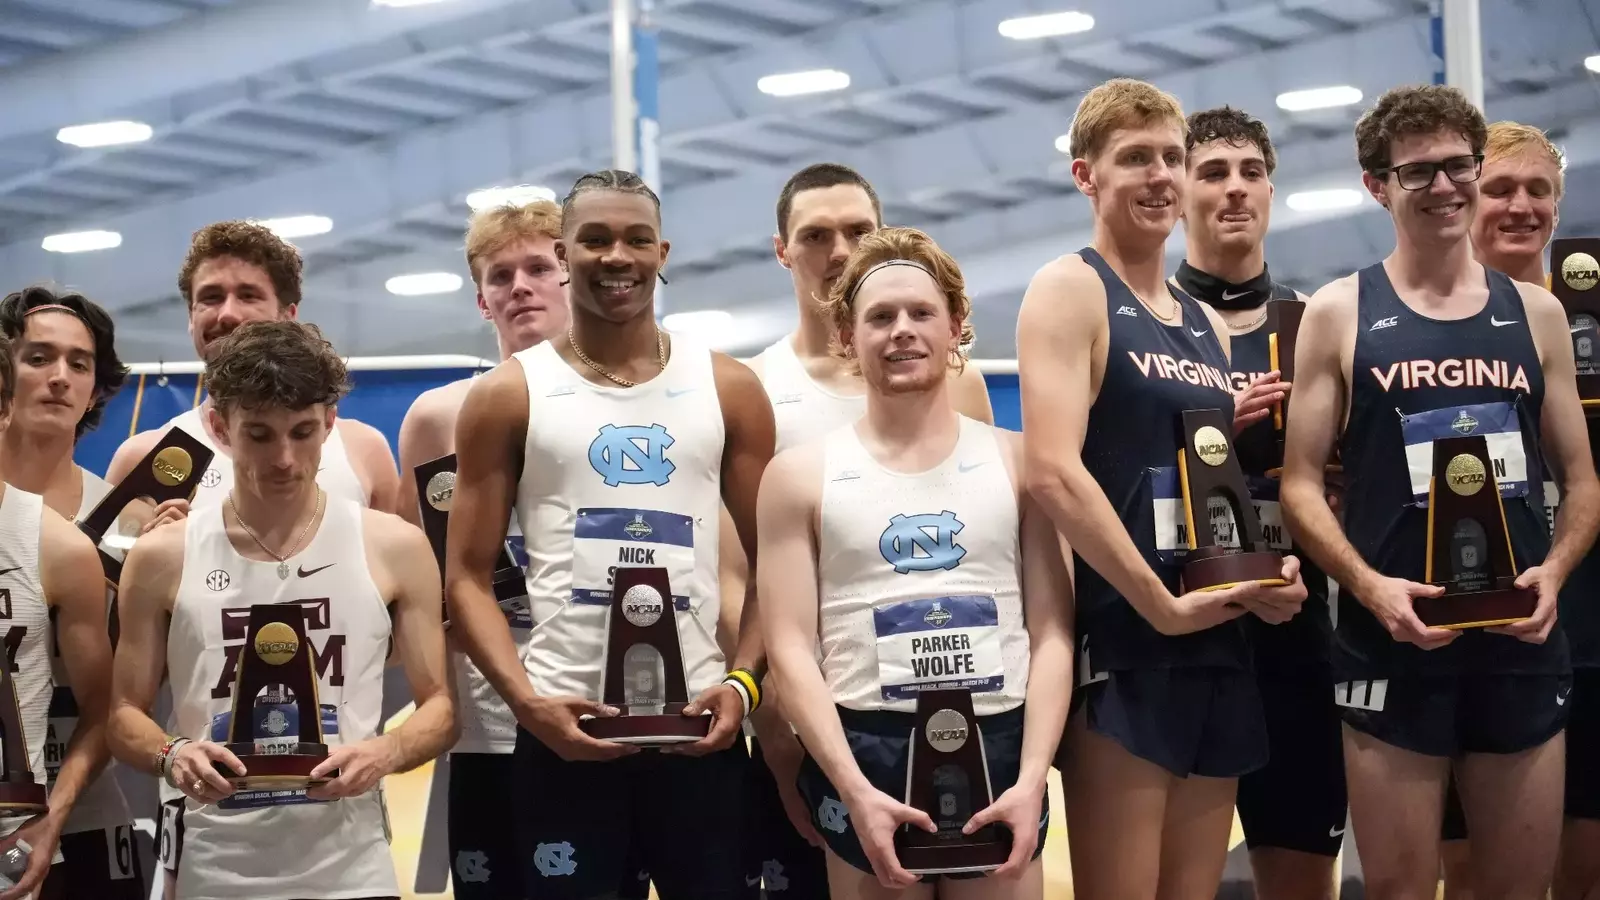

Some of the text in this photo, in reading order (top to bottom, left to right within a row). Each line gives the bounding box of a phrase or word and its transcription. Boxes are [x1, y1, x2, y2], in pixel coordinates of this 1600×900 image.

[1566, 271, 1600, 282] NCAA
[1117, 305, 1137, 317] ACC
[1370, 316, 1398, 331] ACC
[1127, 351, 1234, 395] VIRGINIA
[1370, 358, 1531, 394] VIRGINIA
[1199, 443, 1230, 457] NCAA
[153, 457, 188, 483] NCAA
[1451, 474, 1486, 486] NCAA
[619, 547, 656, 565] NICK
[207, 570, 230, 590] SEC
[626, 604, 662, 615] NCAA
[258, 641, 297, 655] NCAA
[912, 634, 970, 654] PARKER
[911, 653, 975, 678] WOLFE
[929, 729, 967, 742] NCAA
